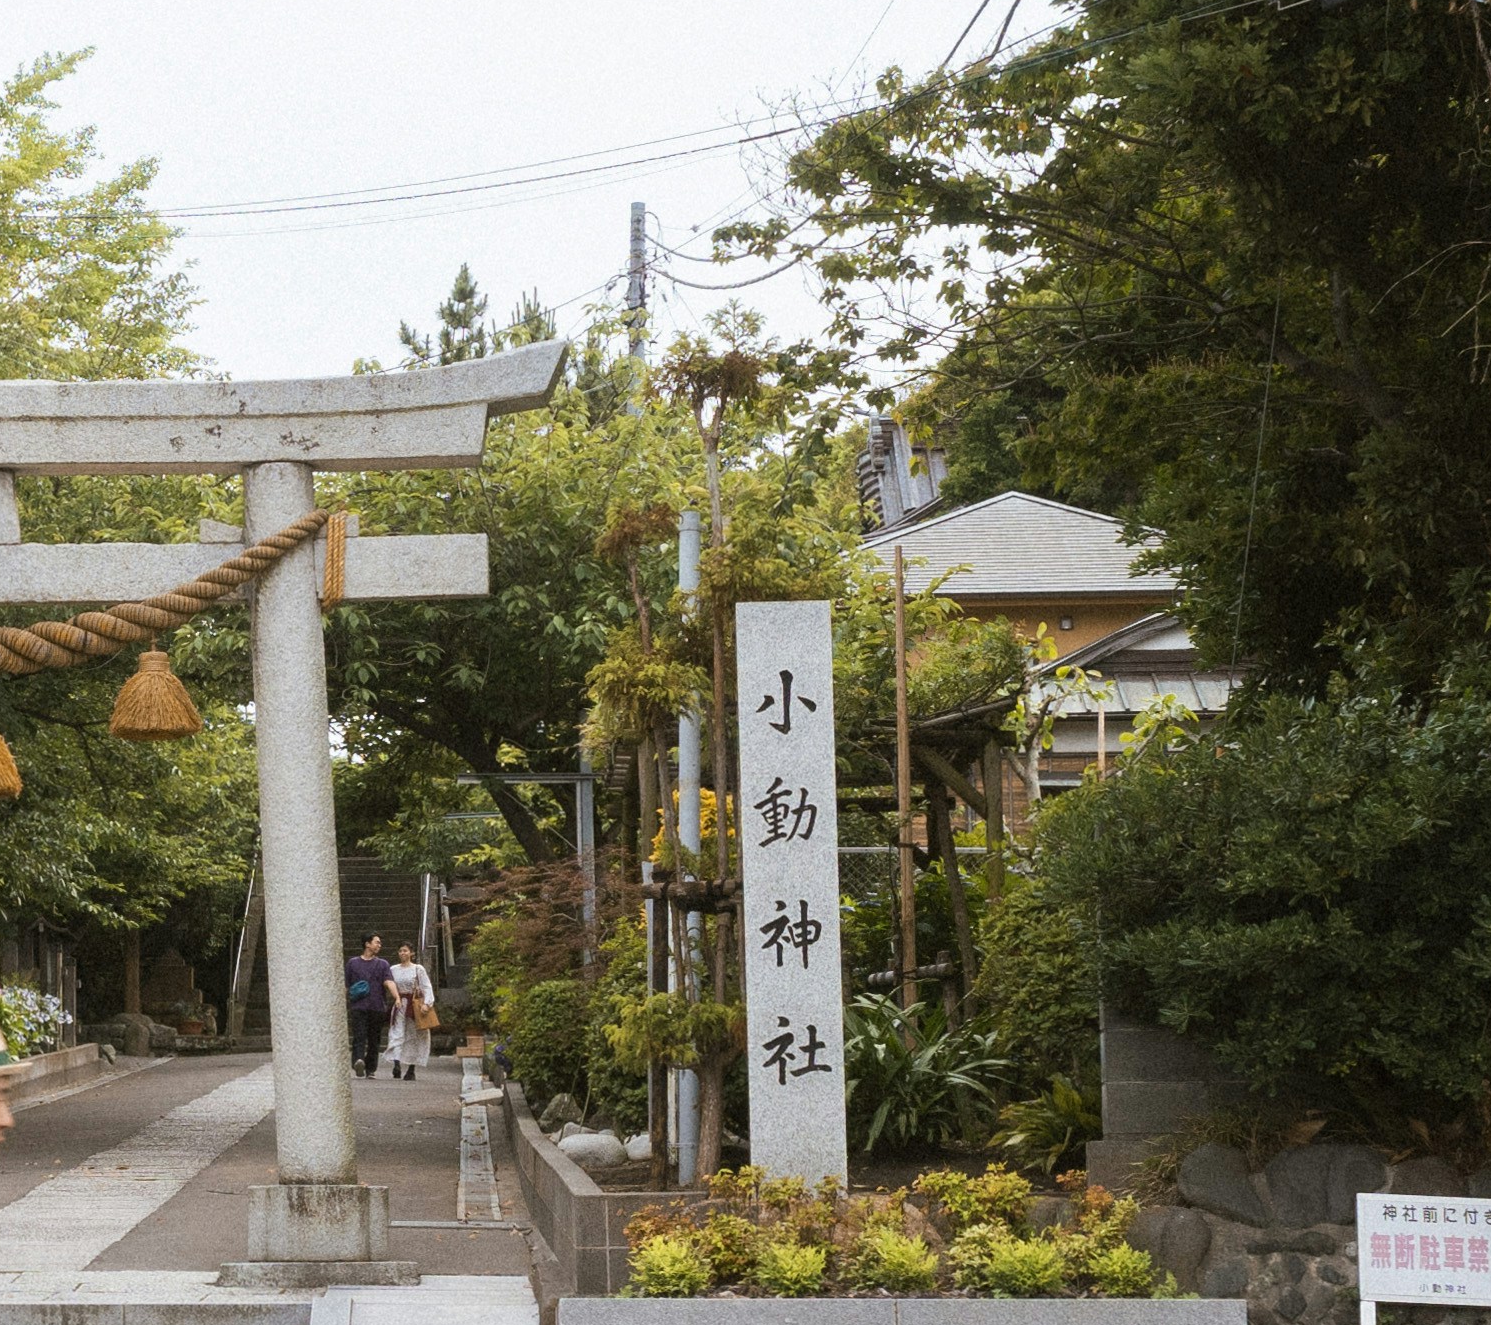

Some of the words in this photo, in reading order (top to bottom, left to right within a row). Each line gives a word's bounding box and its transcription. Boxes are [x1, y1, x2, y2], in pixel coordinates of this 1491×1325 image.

[753, 668, 833, 1087] 小動神社
[1419, 1283, 1467, 1295] 小動神社
